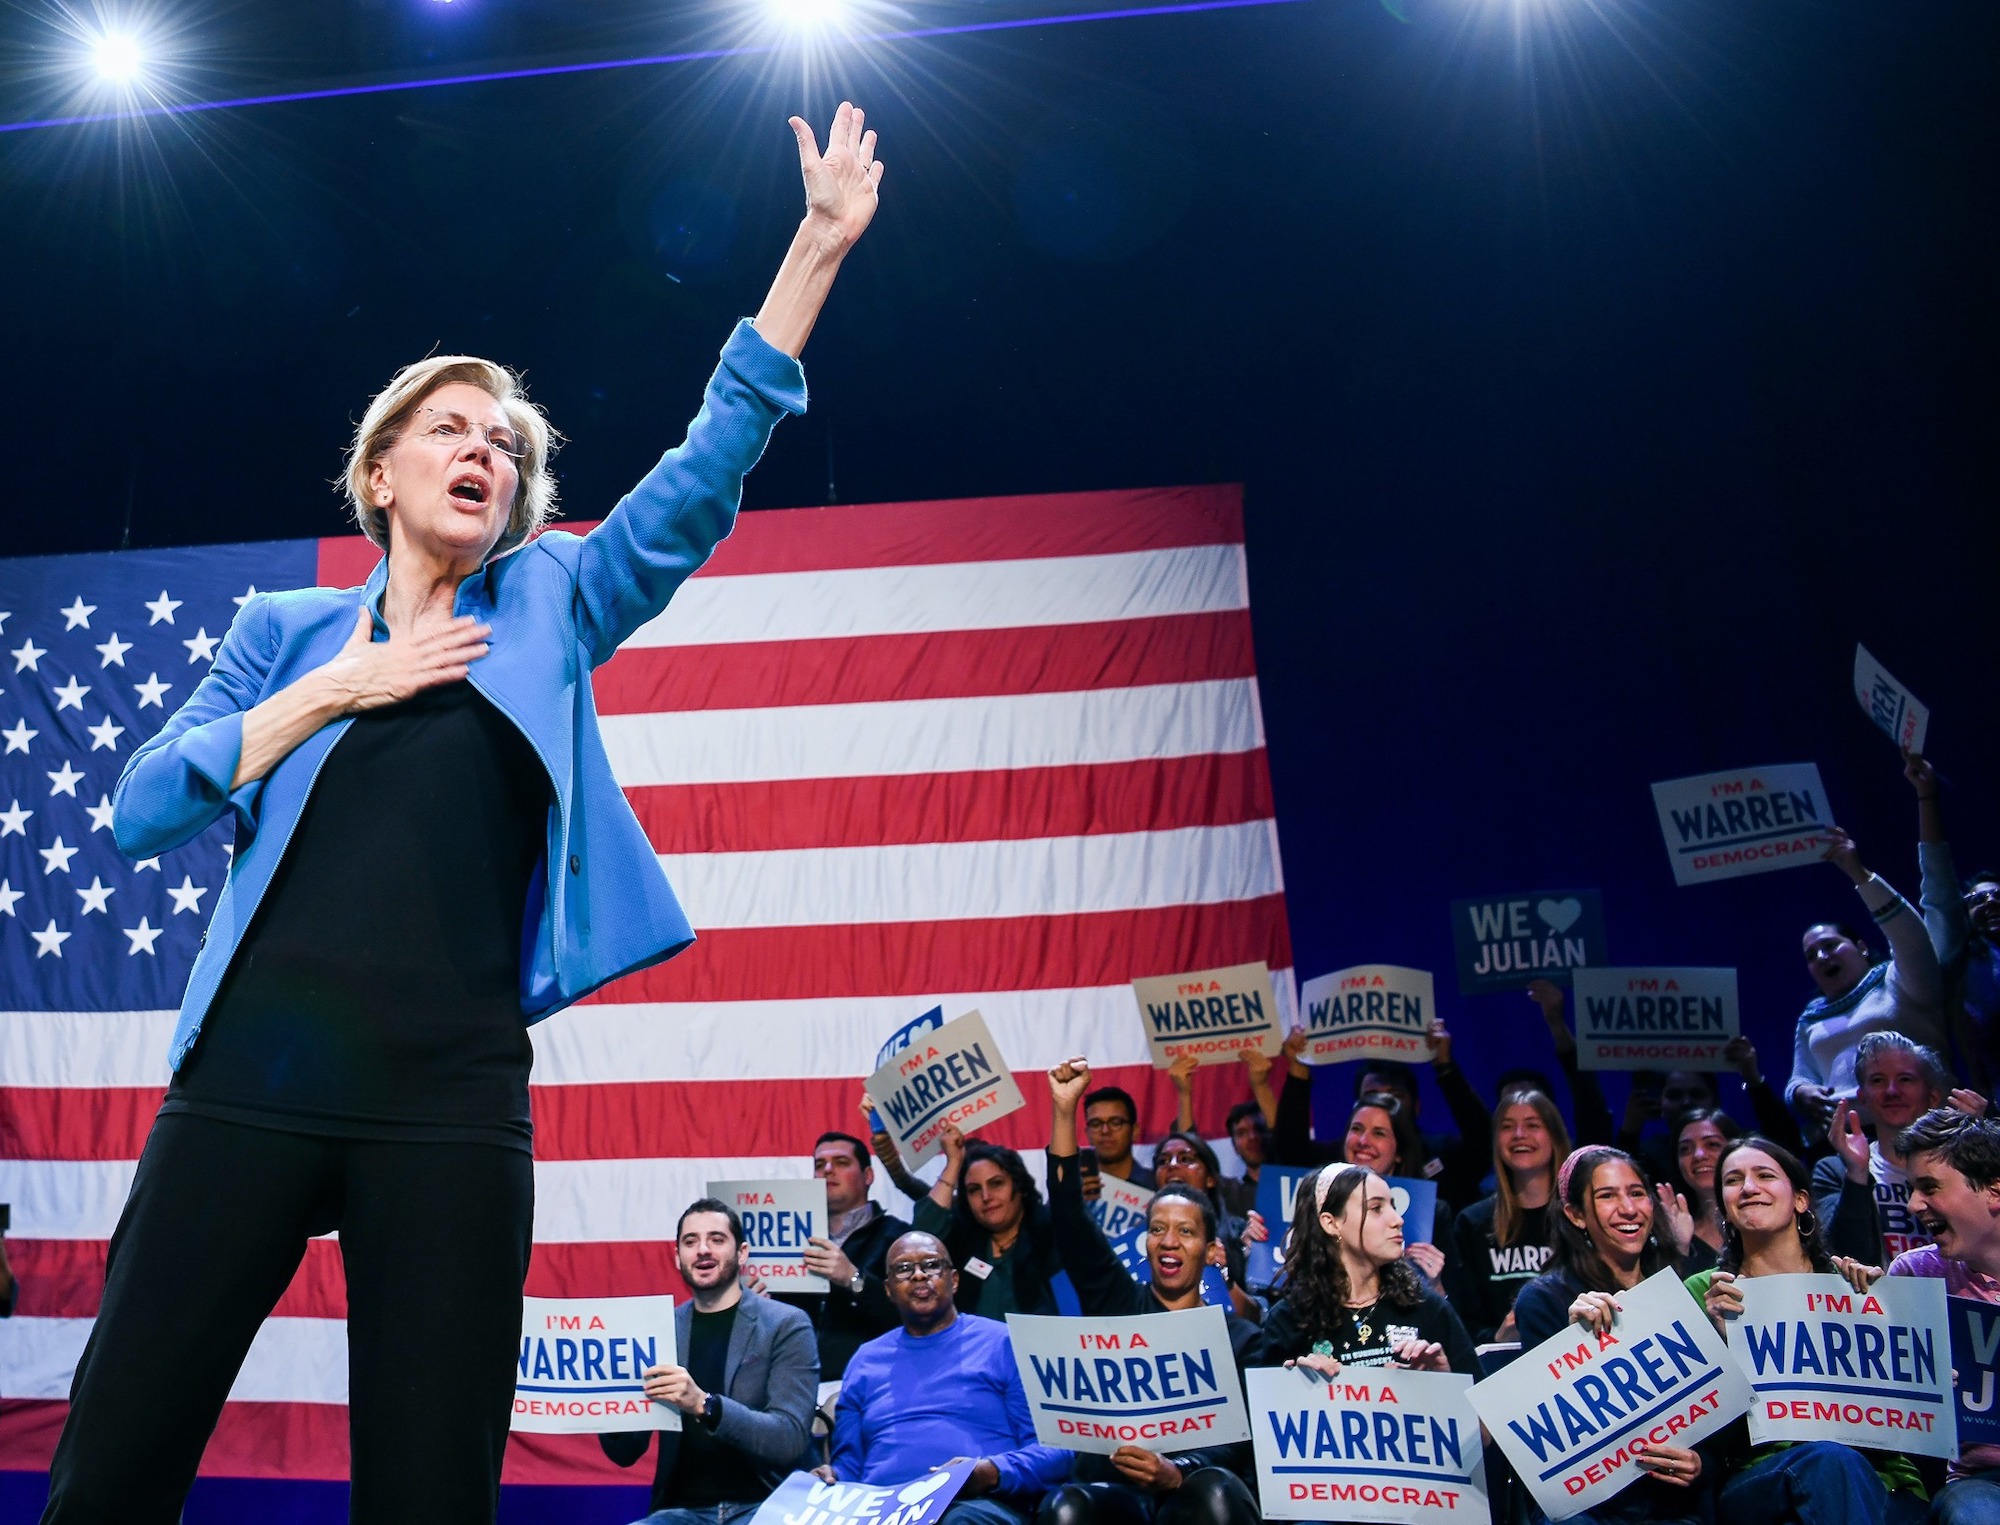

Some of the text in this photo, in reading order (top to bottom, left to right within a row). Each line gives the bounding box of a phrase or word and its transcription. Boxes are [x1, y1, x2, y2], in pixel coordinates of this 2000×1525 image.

[1711, 778, 1765, 797] I'M A
[1671, 789, 1818, 843] WARREN
[1693, 837, 1817, 870] DEMOCRAT
[1469, 901, 1532, 942] WE
[1474, 928, 1586, 974] JULIÁN
[1178, 980, 1221, 996] I'M A
[1341, 975, 1385, 990] I'M A
[1627, 978, 1680, 992] I'M A
[1147, 990, 1265, 1033] WARREN
[1309, 990, 1422, 1030] WARREN
[1585, 996, 1724, 1030] WARREN
[1164, 1035, 1265, 1057] DEMOCRAT
[1314, 1035, 1419, 1054] DEMOCRAT
[1596, 1045, 1719, 1059] DEMOCRAT
[899, 1046, 940, 1077] I'M A
[883, 1042, 992, 1130] WARREN
[911, 1091, 998, 1152] DEMOCRAT
[736, 1193, 775, 1205] I'M A
[742, 1211, 814, 1247] RREN
[1807, 1293, 1884, 1315] I'M A
[546, 1315, 605, 1330] I'M A
[1080, 1333, 1149, 1350] I'M A
[1547, 1330, 1620, 1380] I'M A
[1744, 1321, 1937, 1385] WARREN
[1030, 1349, 1218, 1403] WARREN
[1507, 1320, 1709, 1464] WARREN
[514, 1399, 656, 1416] DEMOCRAT
[1328, 1384, 1398, 1404] I'M A
[1057, 1413, 1217, 1441] DEMOCRAT
[1766, 1401, 1935, 1433] DEMOCRAT
[1268, 1410, 1463, 1469] WARREN
[1563, 1389, 1720, 1496] DEMOCRAT
[806, 1481, 895, 1518] WE
[1289, 1483, 1460, 1510] DEMOCRAT
